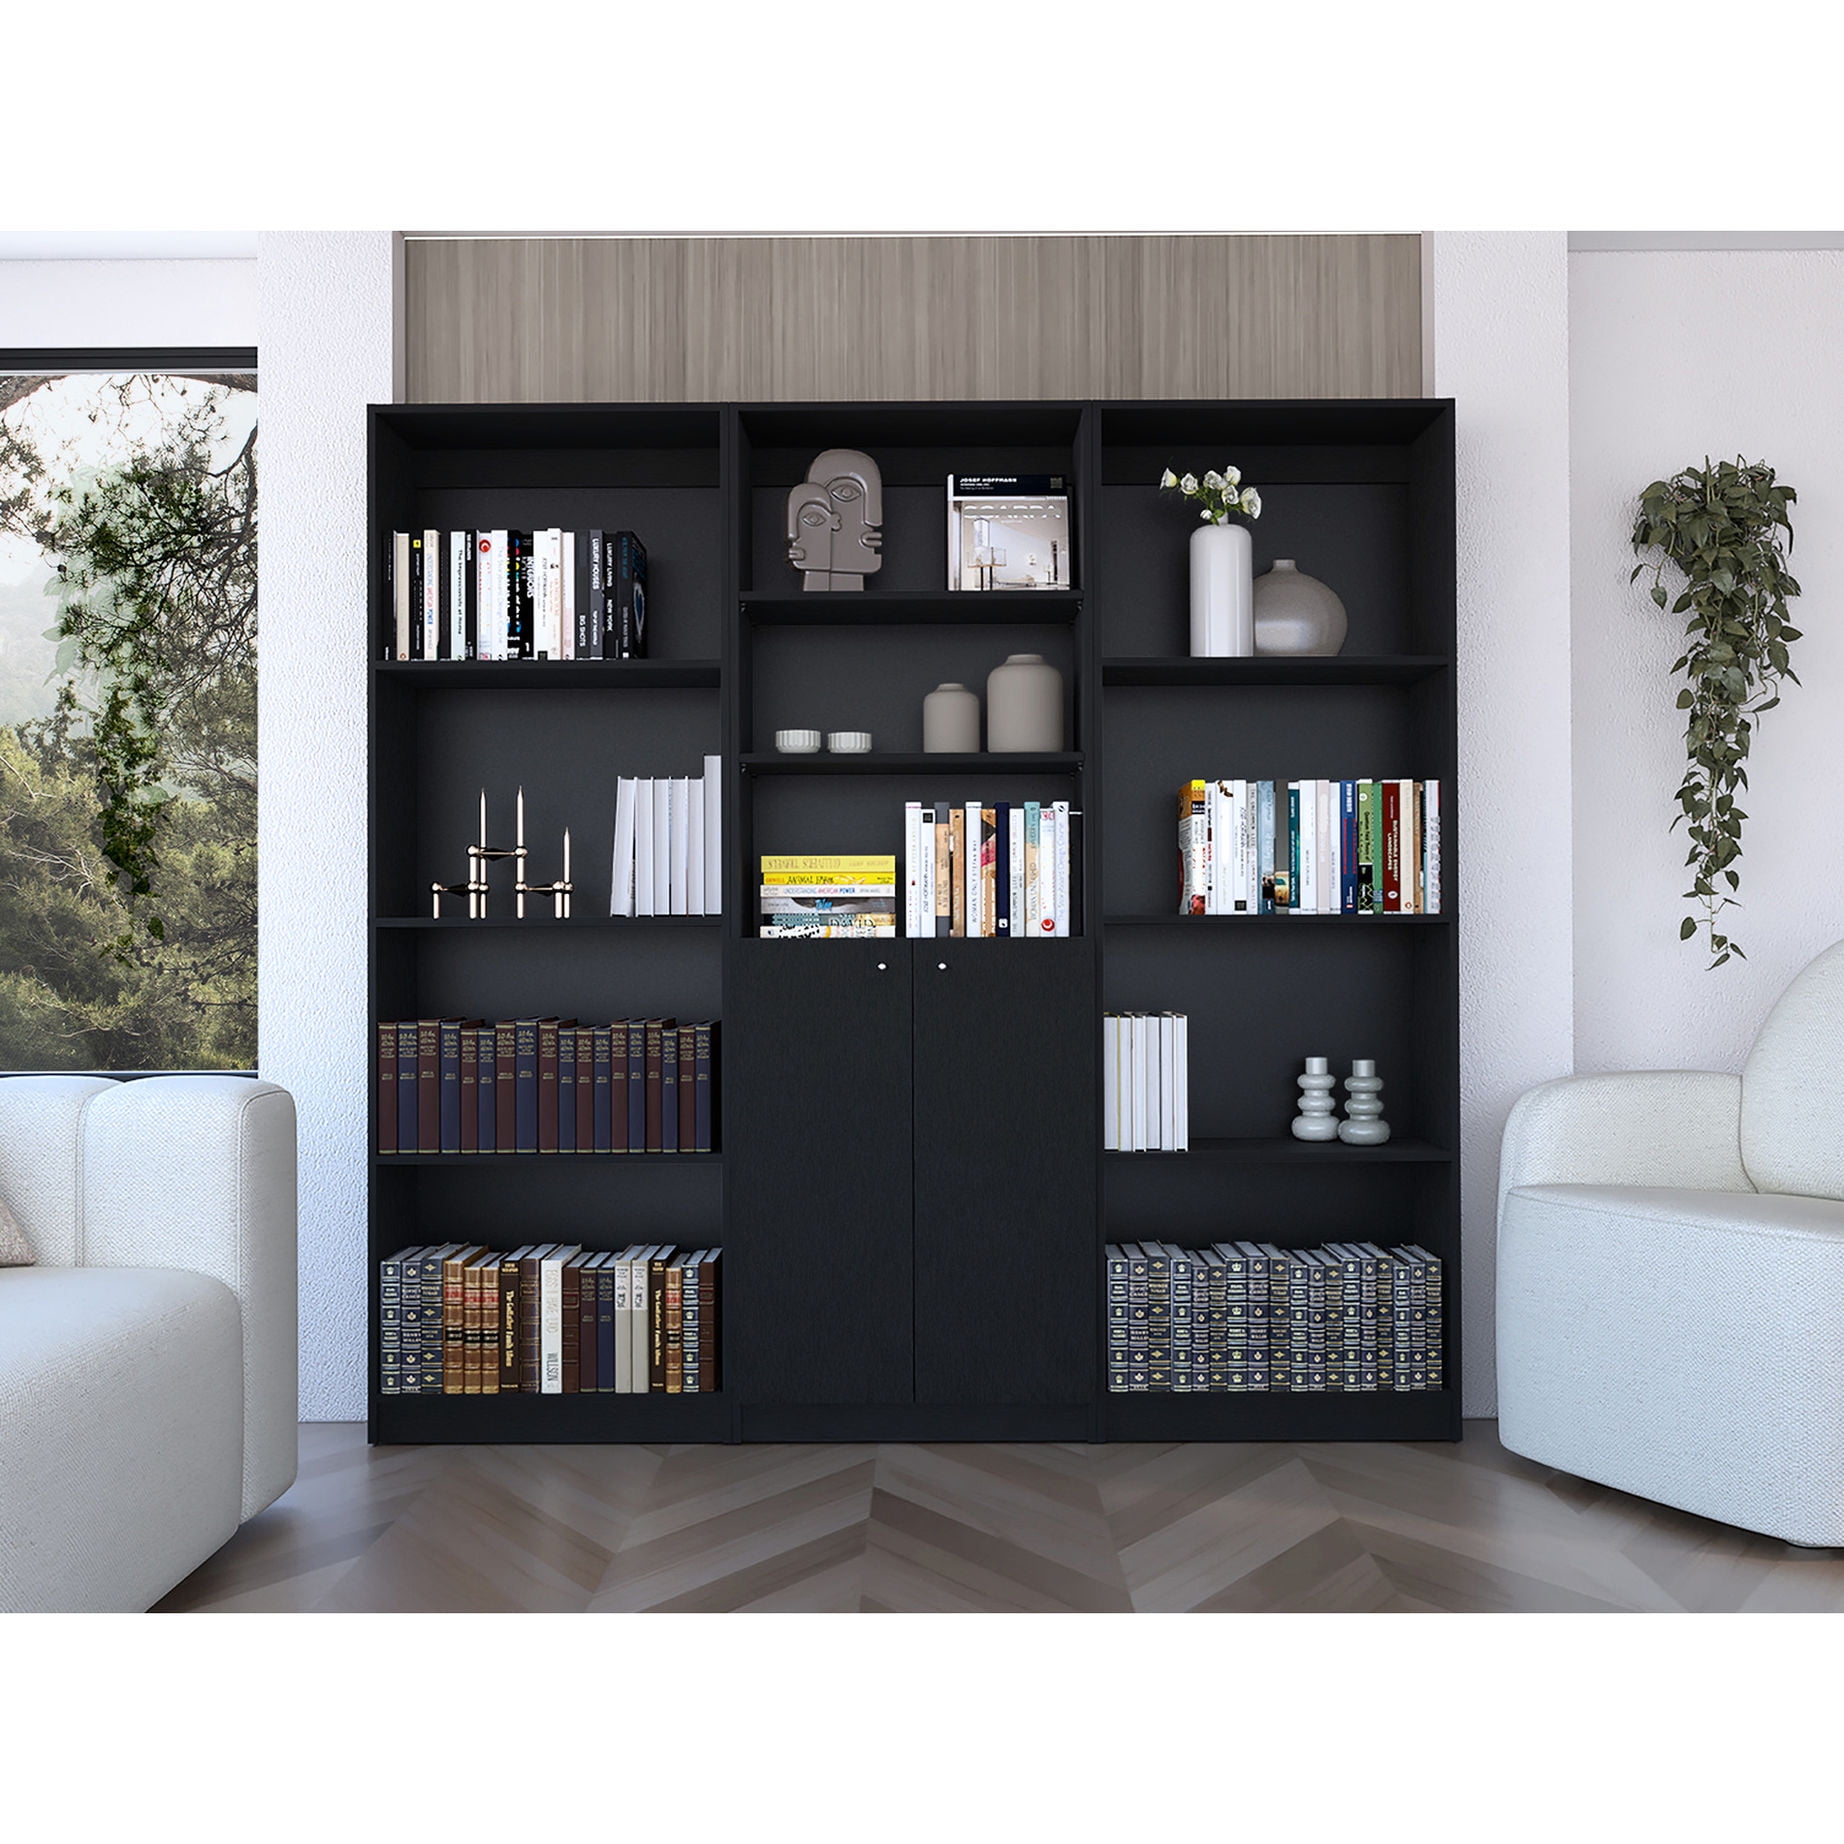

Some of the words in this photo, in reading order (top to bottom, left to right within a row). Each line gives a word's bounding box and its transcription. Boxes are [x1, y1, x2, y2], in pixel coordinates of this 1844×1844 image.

[506, 1291, 515, 1302] The
[506, 1302, 515, 1330] Godfather
[506, 1331, 515, 1349] Family
